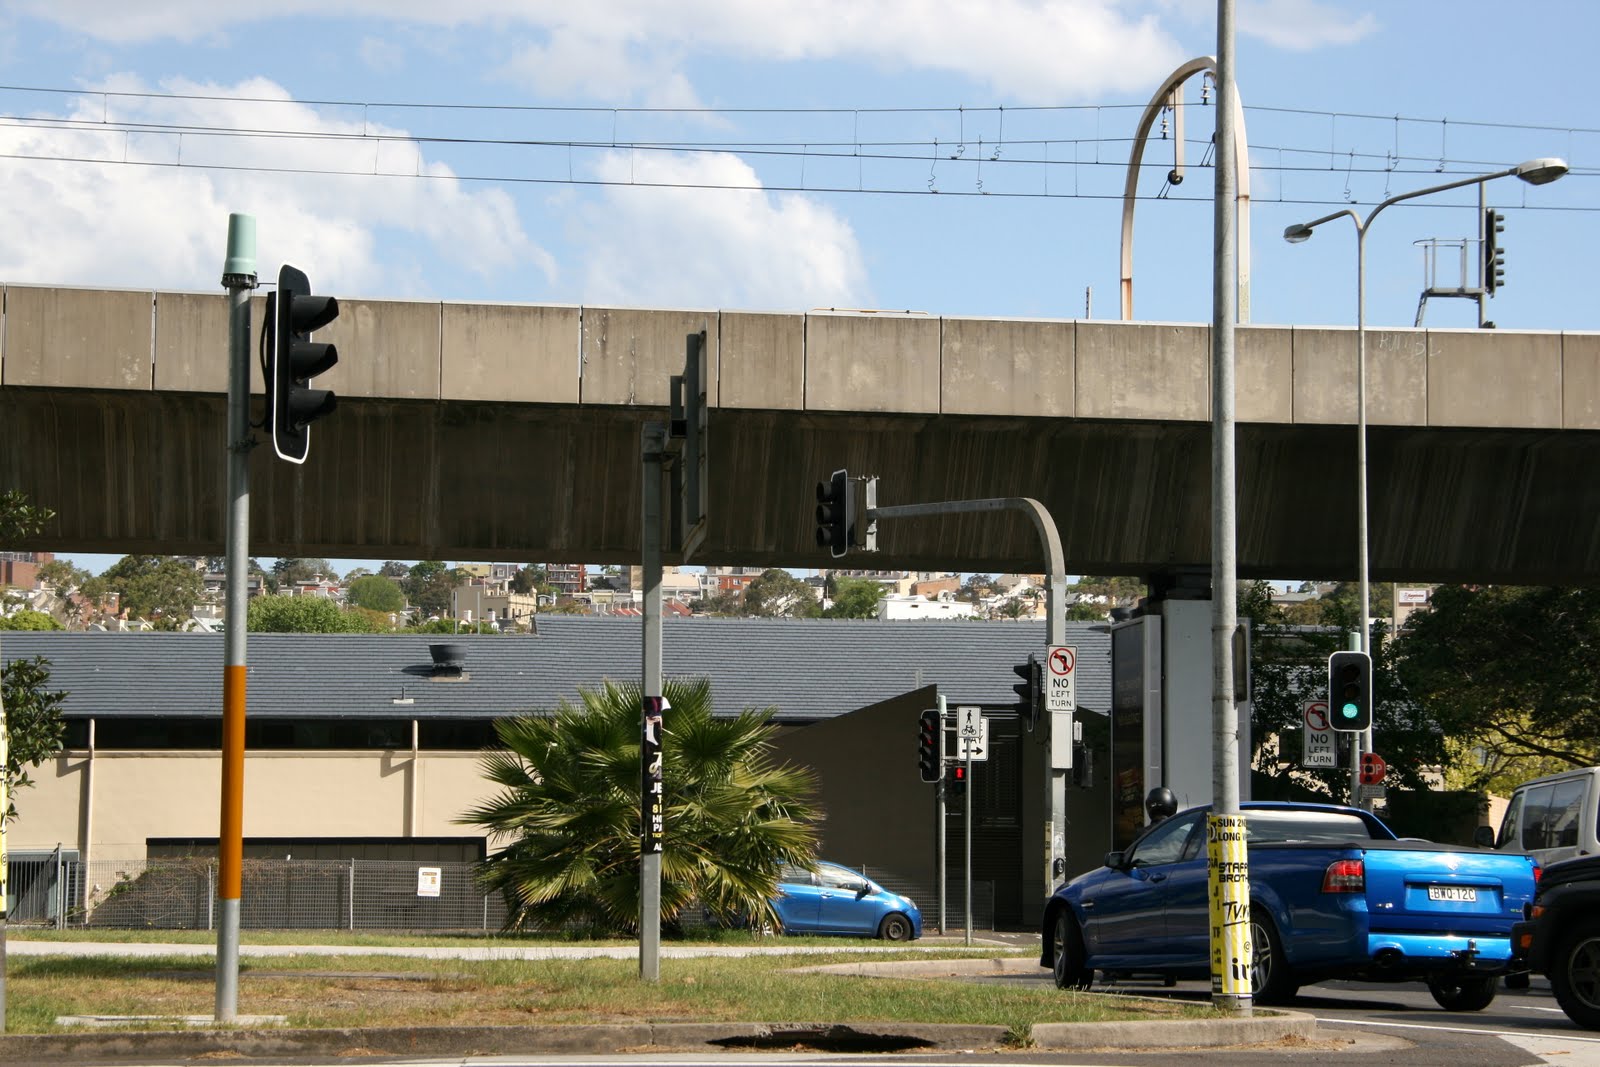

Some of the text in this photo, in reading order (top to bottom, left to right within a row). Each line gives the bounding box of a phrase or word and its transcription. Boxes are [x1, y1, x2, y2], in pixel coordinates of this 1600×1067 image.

[1052, 678, 1069, 689] NO
[1310, 734, 1329, 744] NO
[1308, 746, 1330, 754] LEFT
[1361, 763, 1383, 775] TOP
[1217, 818, 1236, 828] SUN
[1217, 832, 1241, 842] LONG
